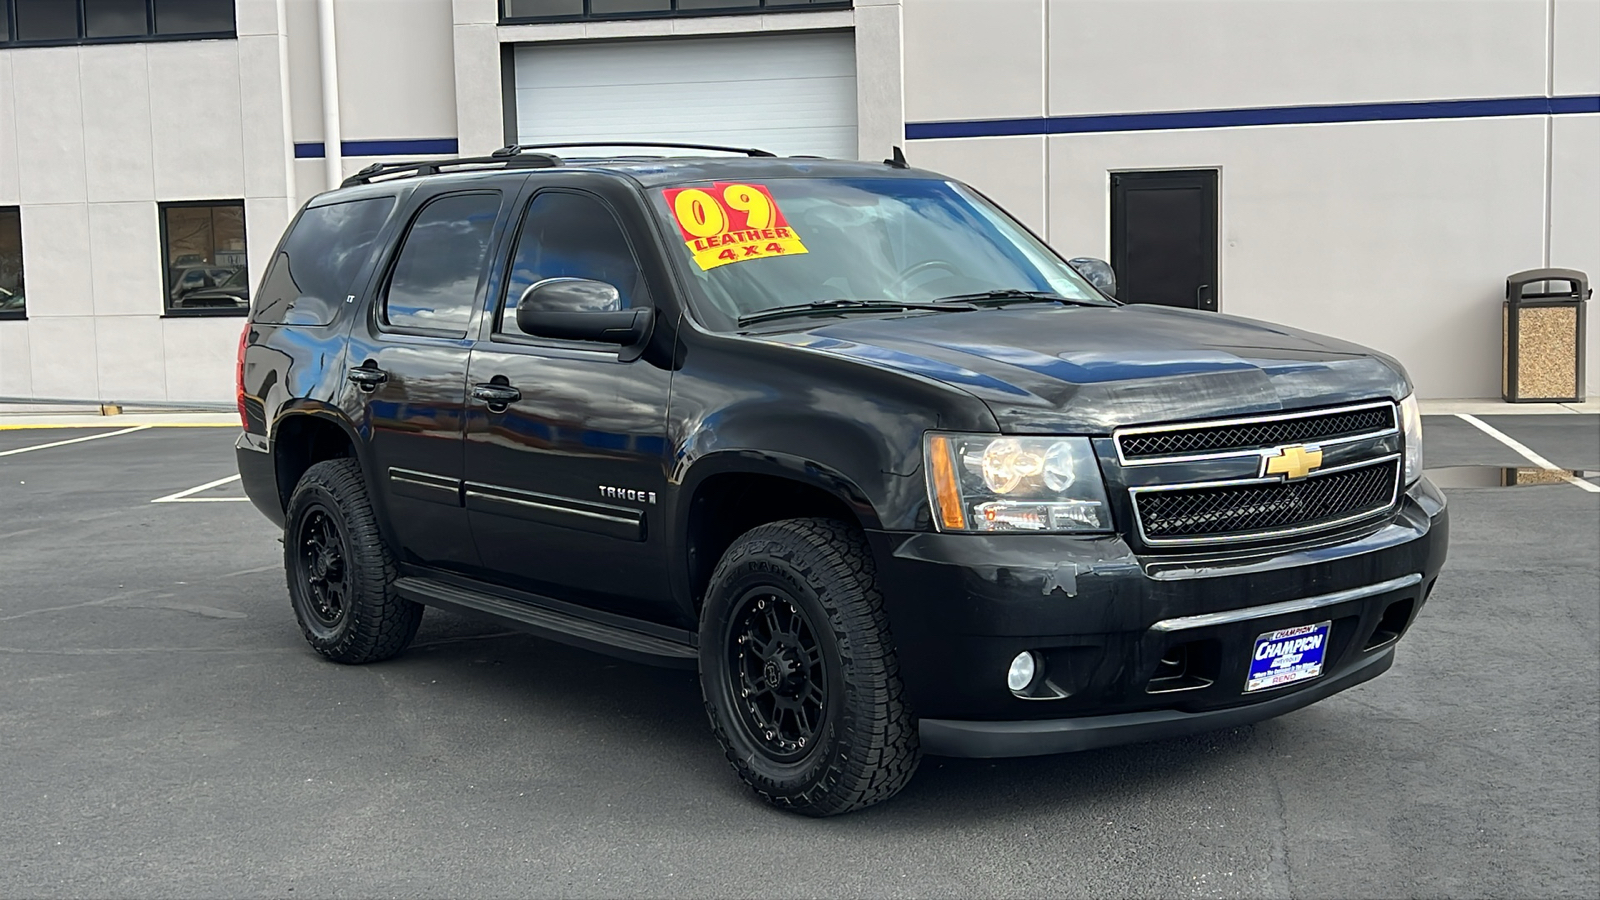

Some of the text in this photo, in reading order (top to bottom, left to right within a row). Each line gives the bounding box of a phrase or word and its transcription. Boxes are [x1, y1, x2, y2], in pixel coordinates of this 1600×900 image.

[674, 184, 777, 238] 09
[694, 228, 792, 252] LEATHER
[598, 485, 646, 502] TAHOE
[1275, 625, 1313, 639] CHAMPION
[1255, 634, 1323, 660] CHAMPION
[1272, 673, 1297, 684] RENO
